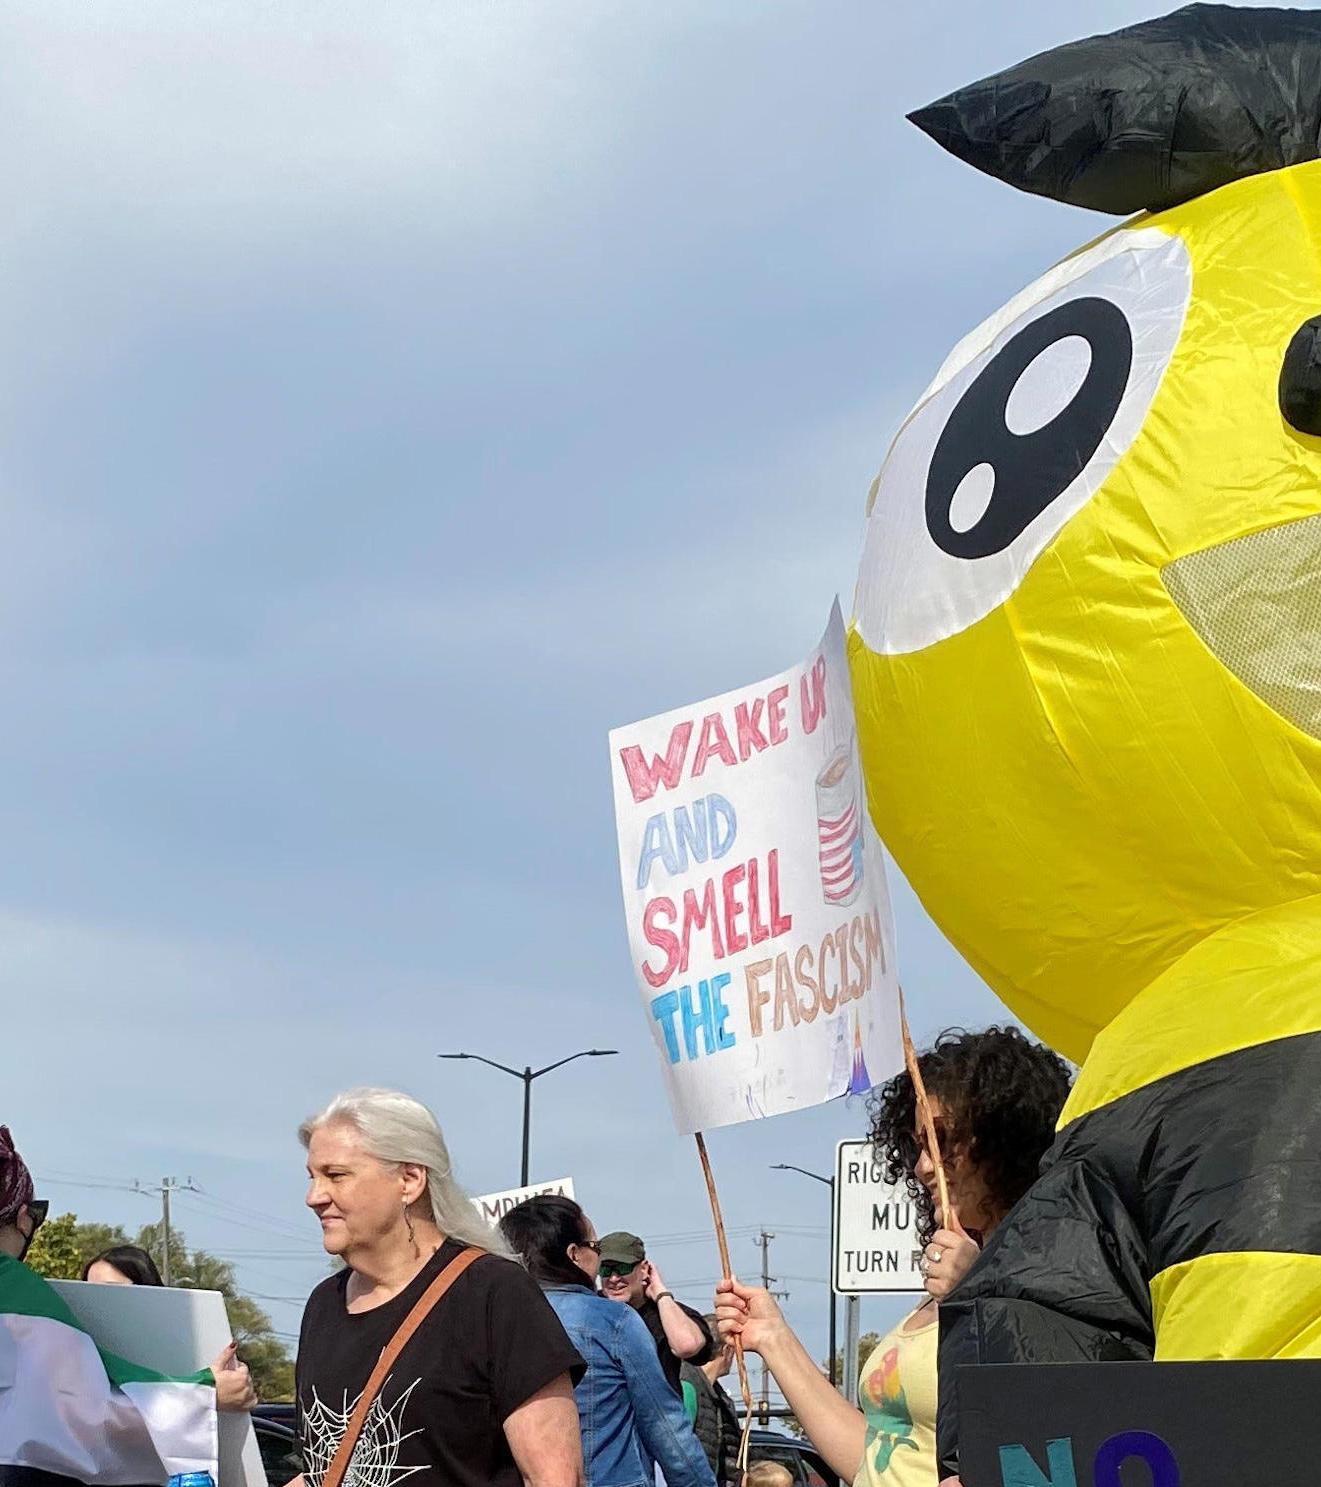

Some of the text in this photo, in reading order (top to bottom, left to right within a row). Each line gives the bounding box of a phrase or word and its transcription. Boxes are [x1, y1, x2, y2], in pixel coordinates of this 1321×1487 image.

[619, 654, 827, 804] WAKE UP
[637, 793, 738, 890] AND
[641, 849, 793, 987] SMELL
[650, 905, 887, 1064] THE FASCISM
[844, 1251, 898, 1272] TURN
[872, 1203, 910, 1230] MU
